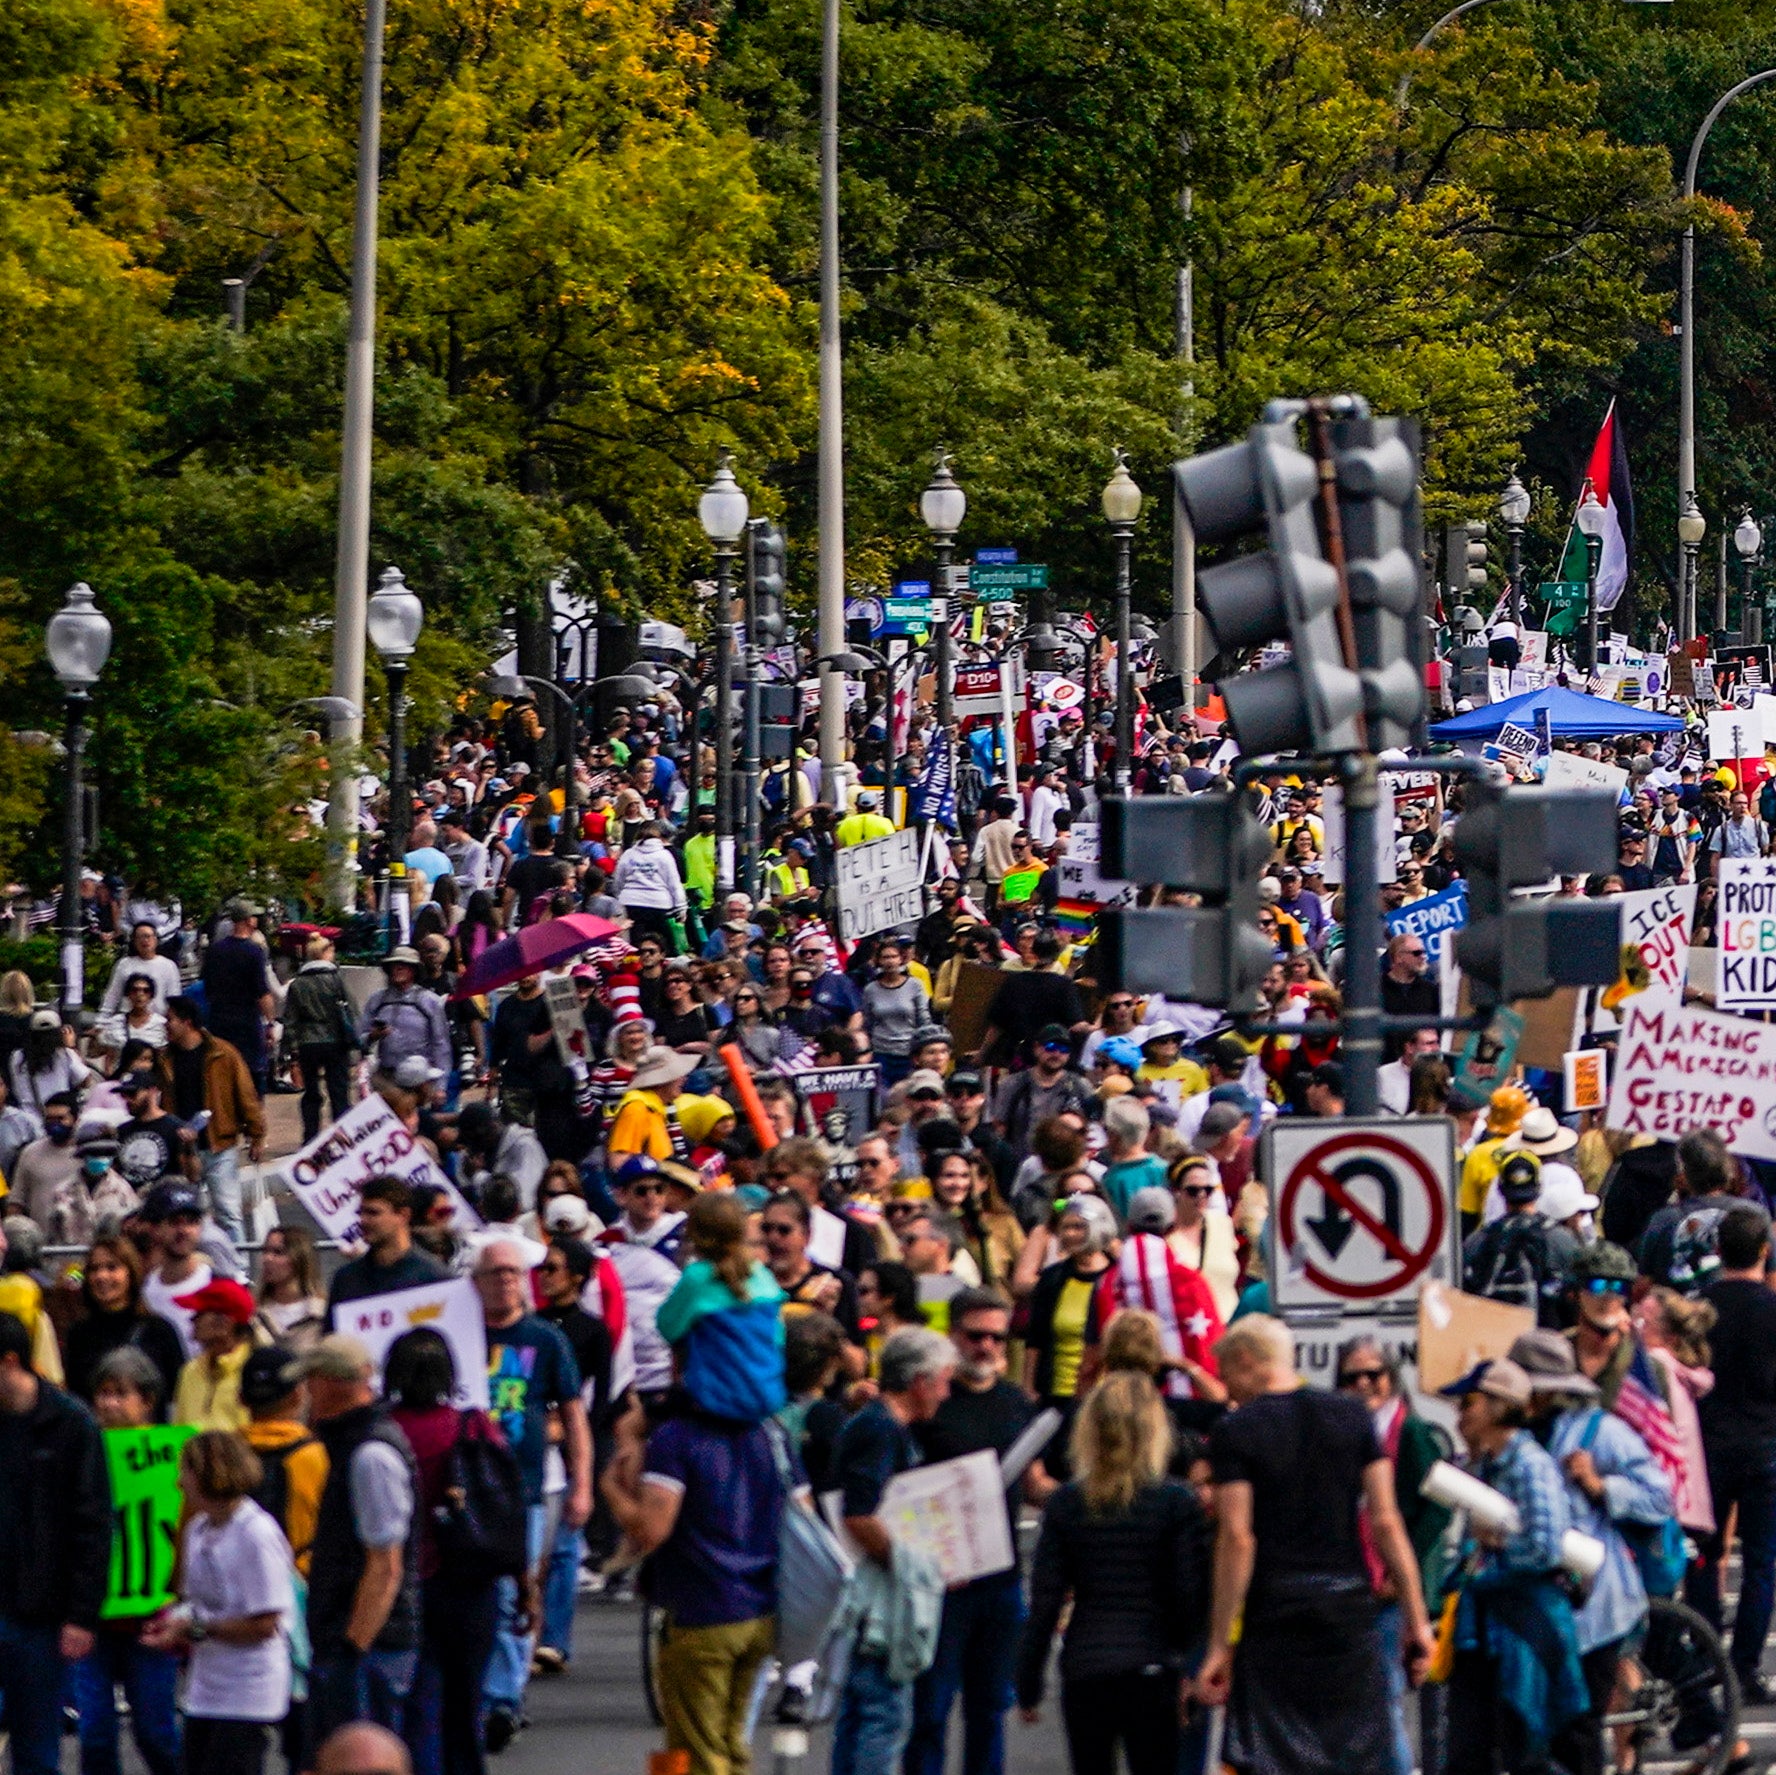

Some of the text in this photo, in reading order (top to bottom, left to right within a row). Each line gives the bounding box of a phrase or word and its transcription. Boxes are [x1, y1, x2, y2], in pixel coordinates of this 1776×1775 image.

[1555, 585, 1563, 597] 4
[920, 752, 949, 816] NO KINGS
[1392, 896, 1464, 938] DEPORT
[1629, 890, 1681, 941] ICE
[1638, 914, 1690, 970] OUT
[1628, 1007, 1761, 1056] MAKING
[1627, 1077, 1757, 1121] GESTAPO
